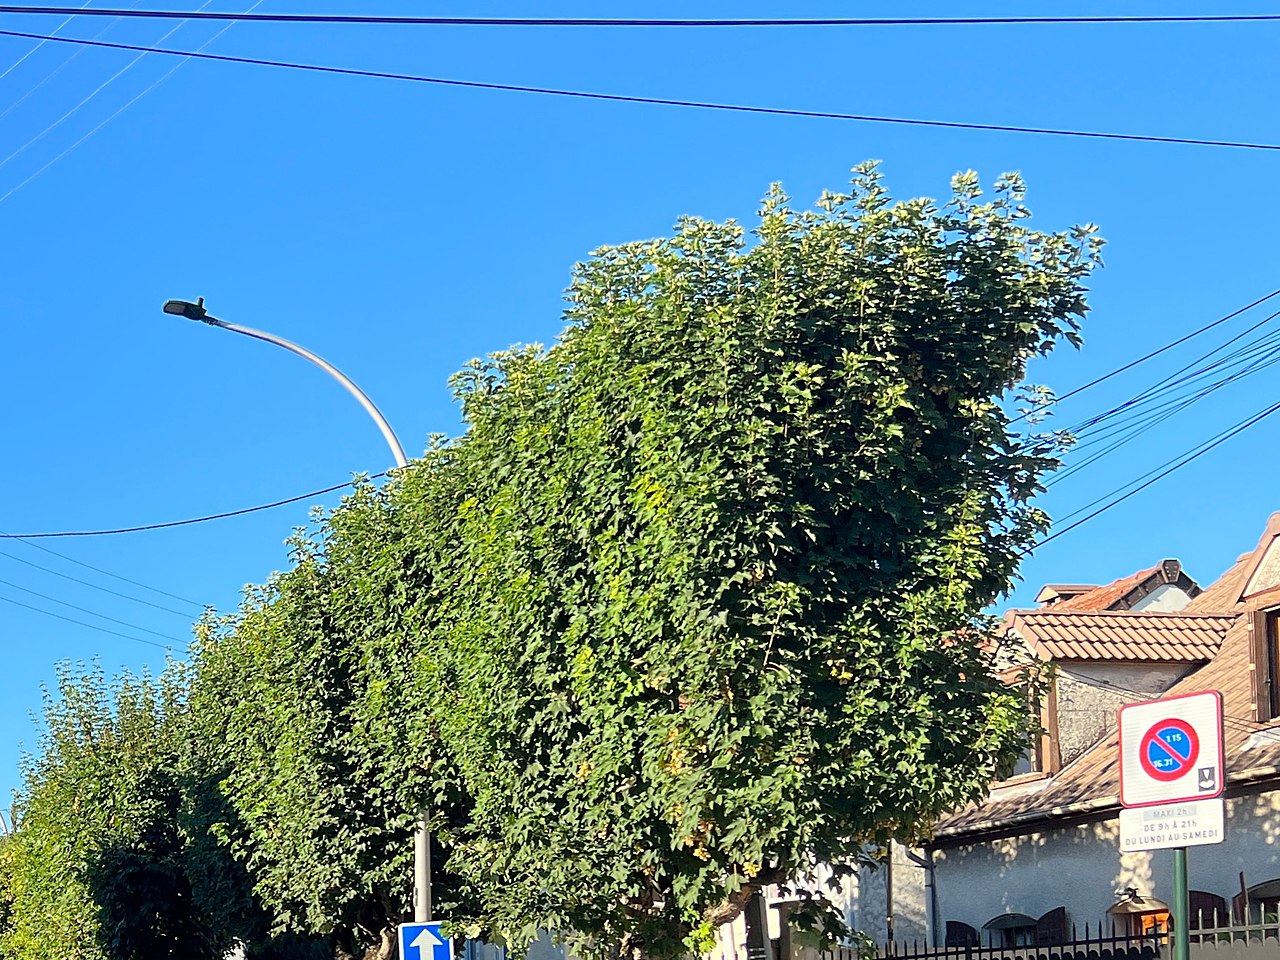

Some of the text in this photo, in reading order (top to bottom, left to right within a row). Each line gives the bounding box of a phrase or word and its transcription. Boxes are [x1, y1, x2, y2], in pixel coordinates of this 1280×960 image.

[1153, 808, 1187, 819] MAXI 2h
[1144, 820, 1197, 832] DE 9h À 21h
[1125, 830, 1218, 846] DU LUNDI AU SAMEDI
